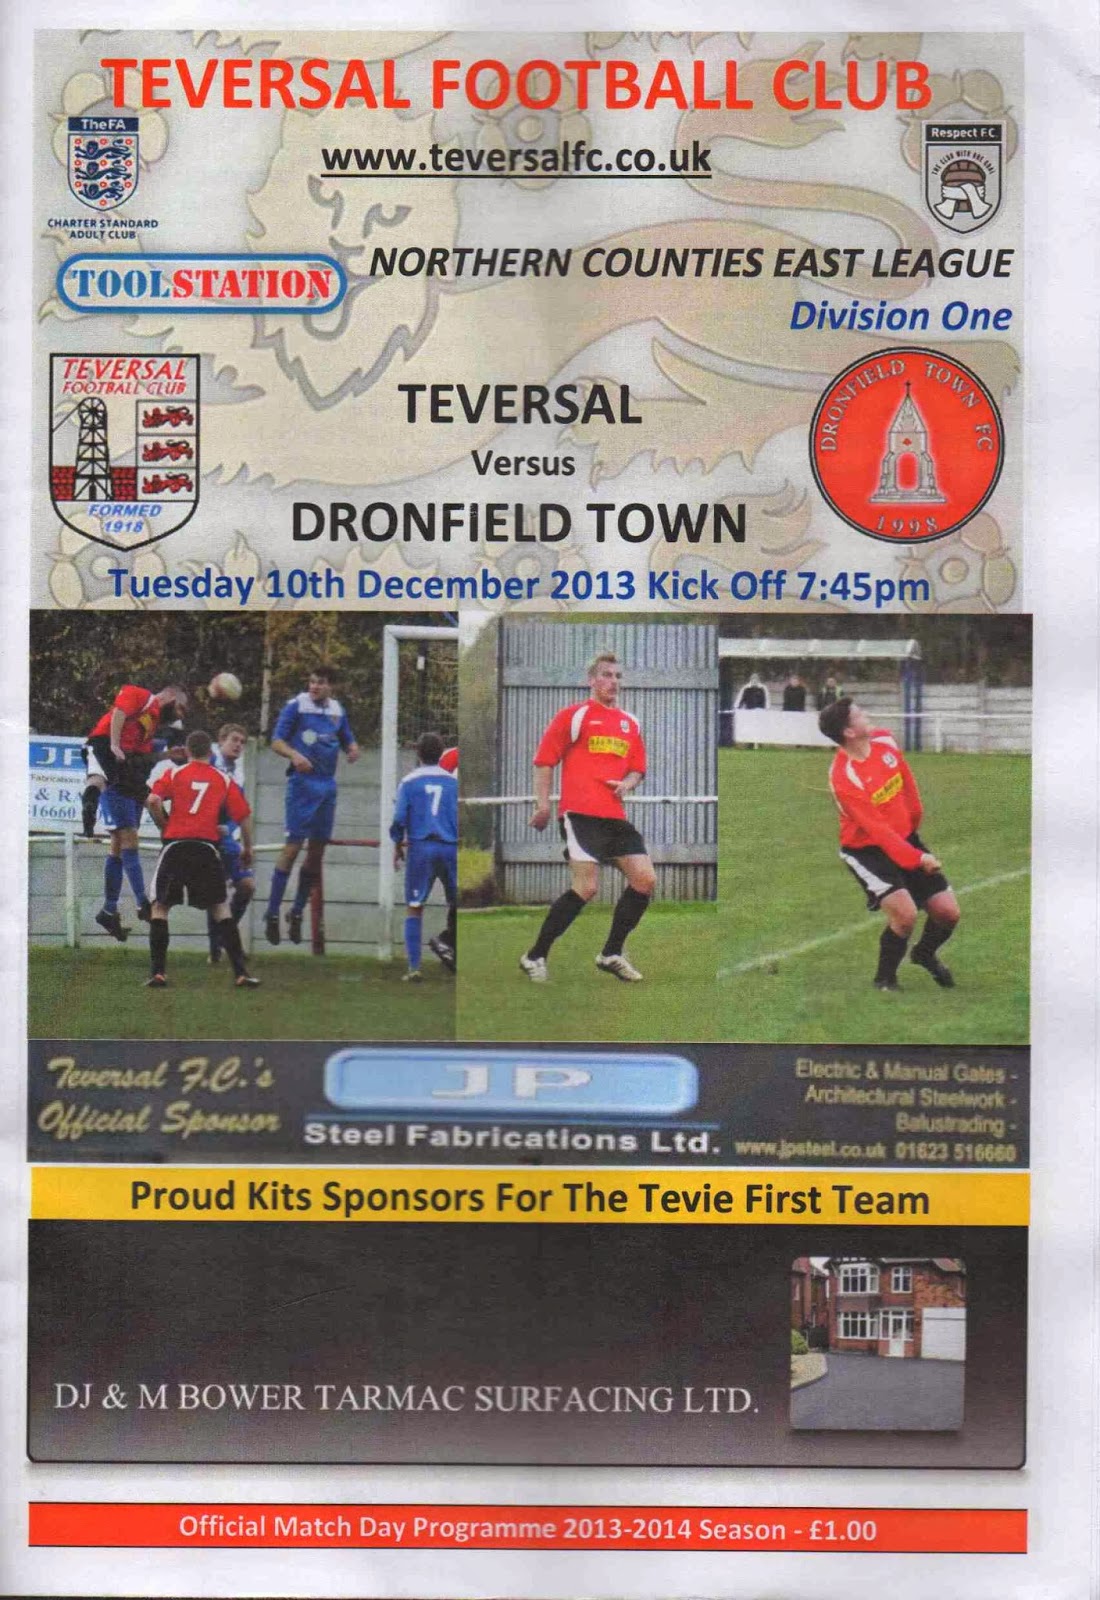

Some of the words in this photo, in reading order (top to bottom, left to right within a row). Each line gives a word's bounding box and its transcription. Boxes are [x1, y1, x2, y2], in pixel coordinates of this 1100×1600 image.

[101, 59, 410, 109] TEVERSAL
[433, 60, 753, 110] FOOTBALL
[773, 60, 932, 110] CLUB
[931, 127, 978, 139] Respect
[322, 140, 711, 172] www.teversalfc.co.uk
[48, 219, 97, 228] CHARTER
[99, 219, 159, 228] STANDARD
[70, 230, 106, 239] ADULT
[108, 231, 136, 239] CLUB
[369, 247, 572, 277] NORTHERN
[583, 248, 763, 278] COUNTIES
[774, 248, 864, 278] EAST
[872, 248, 1015, 279] LEAGUE
[72, 269, 332, 299] TOOLSTATION
[790, 301, 930, 331] Division
[942, 302, 1012, 331] One
[64, 358, 186, 380] TEVERSAL
[62, 381, 140, 395] FOOTBALL
[146, 381, 187, 395] CLUB
[398, 384, 643, 424] TEVERSAL
[820, 359, 905, 451] DRONFIELD
[924, 361, 981, 408] TOWN
[974, 423, 993, 451] FC
[472, 449, 576, 476] Versus
[88, 504, 162, 517] FORMED
[292, 502, 572, 542] DRONFIELD
[587, 503, 747, 544] TOWN
[876, 515, 939, 533] 1998
[104, 521, 144, 533] 1918
[110, 569, 253, 605] Tuesday
[267, 569, 345, 599] 10th
[359, 570, 539, 600] December
[551, 571, 635, 601] 2013
[648, 571, 718, 600] Kick
[730, 571, 786, 601] Off
[798, 572, 930, 607] 7:45pm
[34, 788, 49, 801] &
[191, 781, 210, 815] 7
[424, 784, 443, 816] 7
[48, 1056, 168, 1089] Teversal
[432, 1063, 593, 1100] JP
[796, 1058, 862, 1080] Electric
[865, 1060, 878, 1079] &
[884, 1062, 948, 1082] Manual
[954, 1064, 1005, 1084] Gates
[804, 1085, 914, 1106] Architectural
[920, 1087, 1004, 1108] Steelwork
[38, 1101, 152, 1140] Official
[161, 1101, 281, 1140] Sponsor
[896, 1111, 1006, 1138] Balustrading
[304, 1122, 394, 1146] Steel
[406, 1125, 638, 1151] Fabrications
[651, 1130, 721, 1154] Ltd.
[895, 1142, 949, 1161] 01623
[954, 1144, 1017, 1162] 516660
[132, 1180, 235, 1211] Proud
[248, 1180, 312, 1211] Kits
[323, 1182, 485, 1218] Sponsors
[497, 1183, 553, 1213] For
[563, 1182, 628, 1213] The
[639, 1184, 734, 1214] Tevie
[746, 1184, 822, 1215] First
[832, 1185, 930, 1215] Team
[54, 1383, 91, 1411] DJ
[102, 1383, 128, 1410] &
[138, 1384, 168, 1410] M
[179, 1384, 304, 1411] BOWER
[314, 1384, 464, 1412] TARMAC
[475, 1386, 674, 1413] SURFACING
[684, 1387, 760, 1414] LTD.
[179, 1515, 265, 1537] Official
[273, 1516, 350, 1537] Match
[360, 1517, 405, 1542] Day
[413, 1517, 556, 1542] Programme
[563, 1518, 692, 1539] 2013-2014
[699, 1520, 786, 1541] Season
[809, 1520, 877, 1541] £1.00
